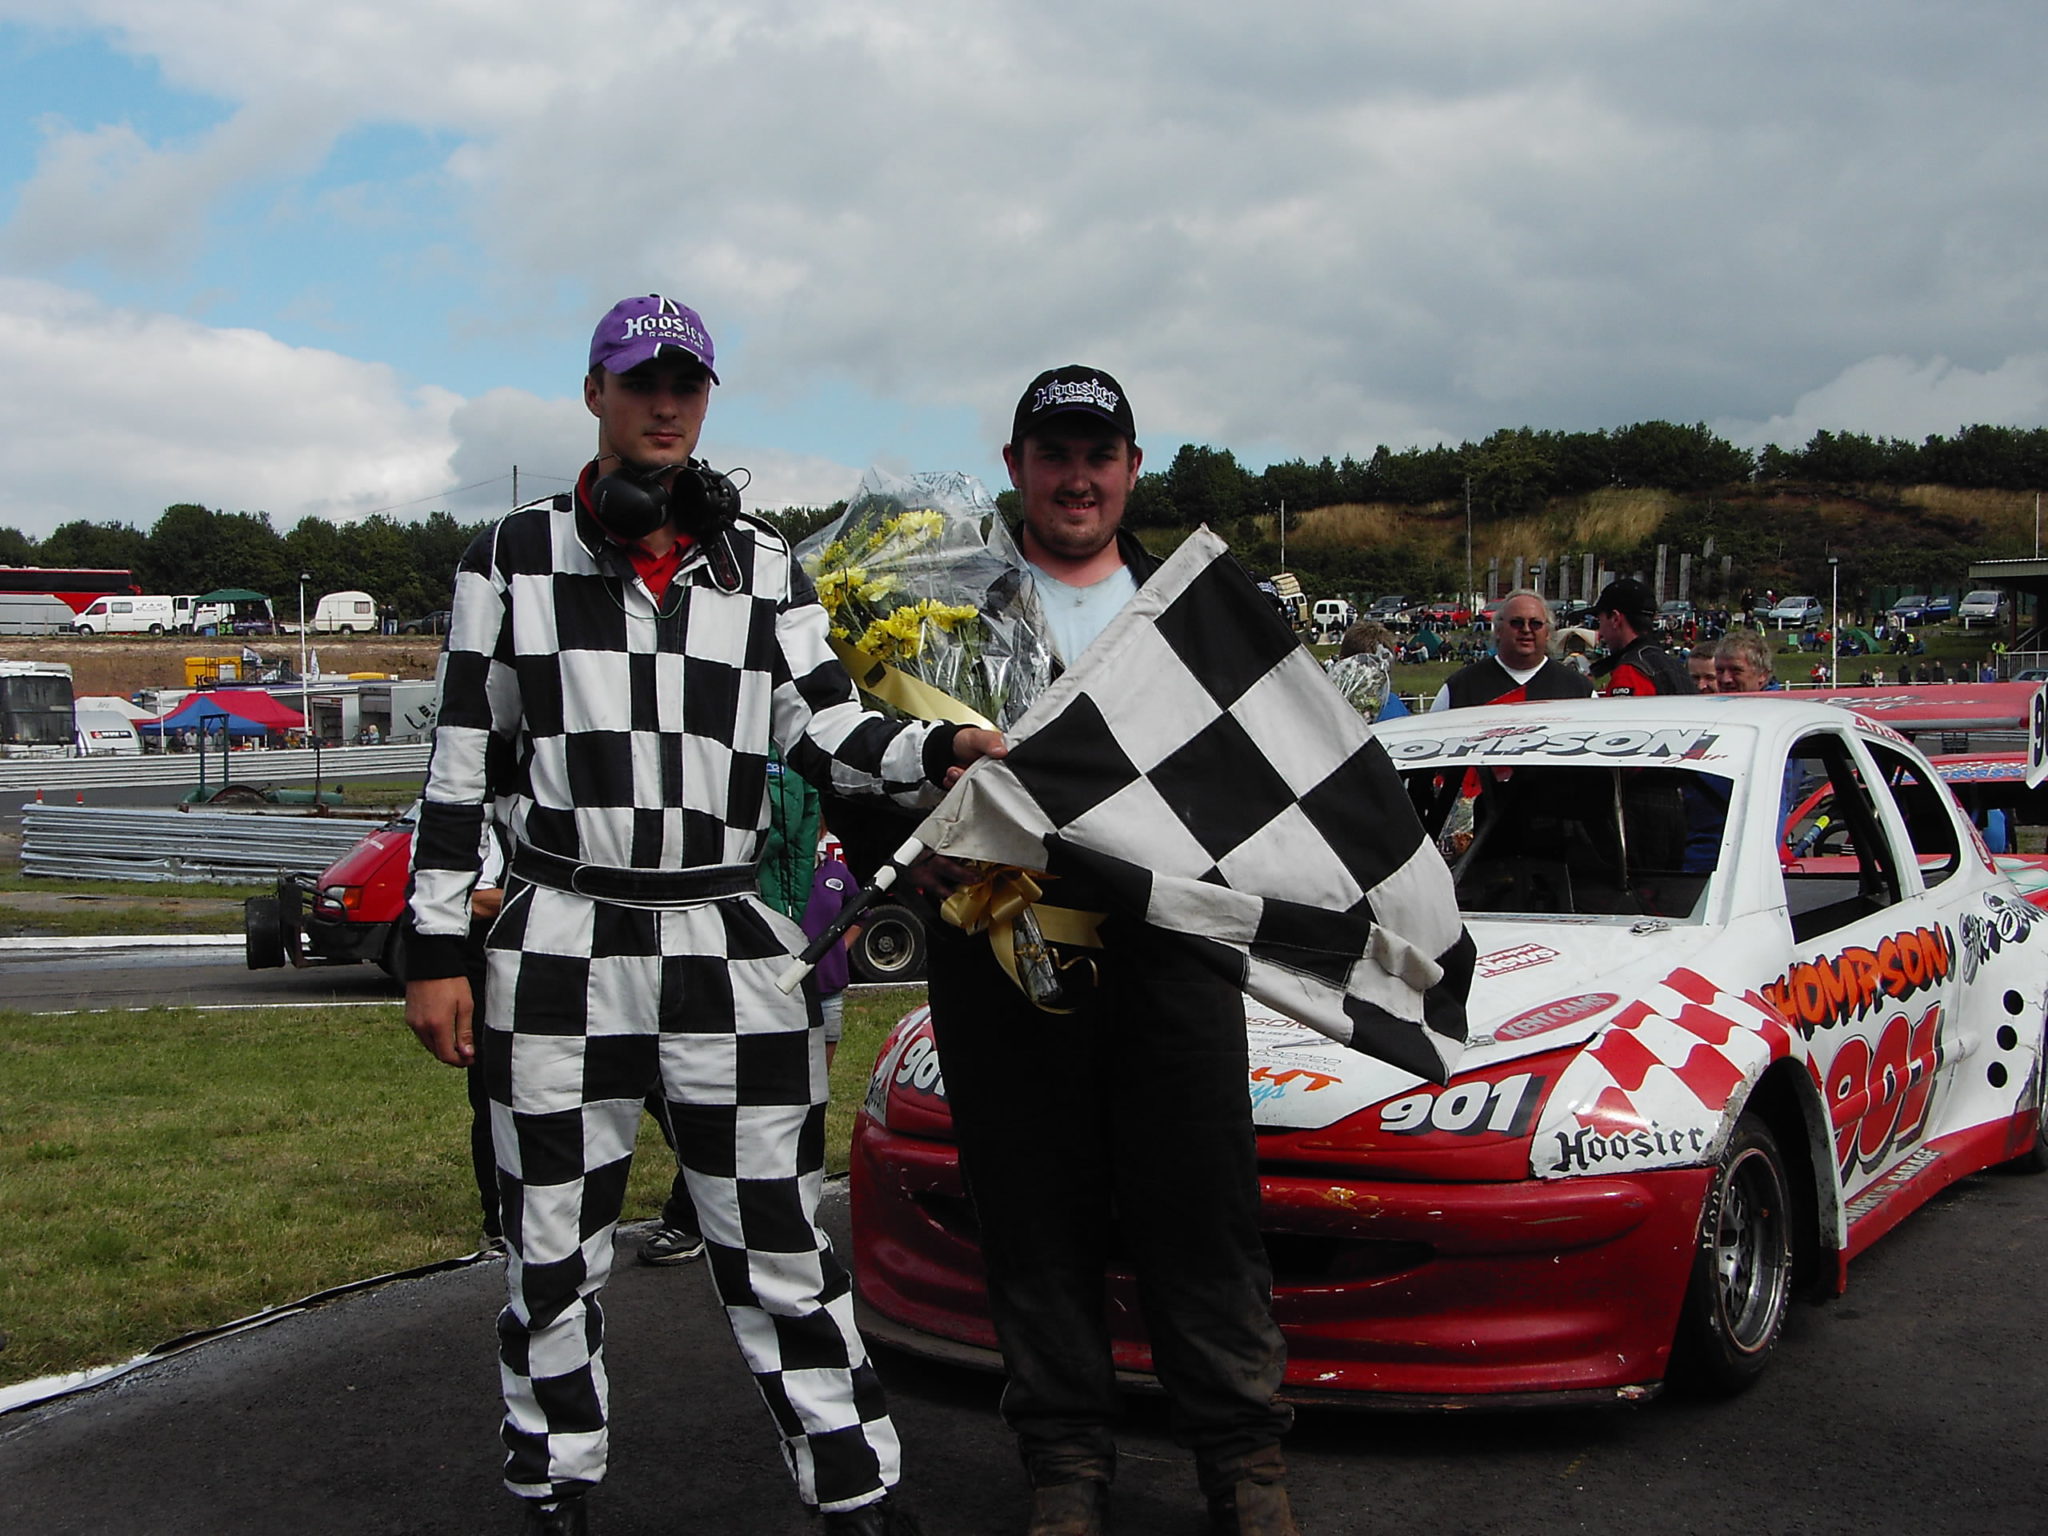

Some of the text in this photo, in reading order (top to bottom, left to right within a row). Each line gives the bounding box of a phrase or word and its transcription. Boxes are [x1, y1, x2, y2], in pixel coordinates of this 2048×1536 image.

[621, 314, 705, 345] Hoosier
[1032, 378, 1119, 413] Hoosier
[1386, 729, 1719, 760] OMPSON
[2034, 686, 2048, 768] 9
[1478, 948, 1557, 975] News
[1501, 994, 1610, 1038] KENT CAMS
[1379, 1072, 1540, 1135] 901
[1824, 1001, 1944, 1186] 901
[1550, 1120, 1704, 1172] Hoosier
[1887, 1148, 1940, 1181] GARAGE
